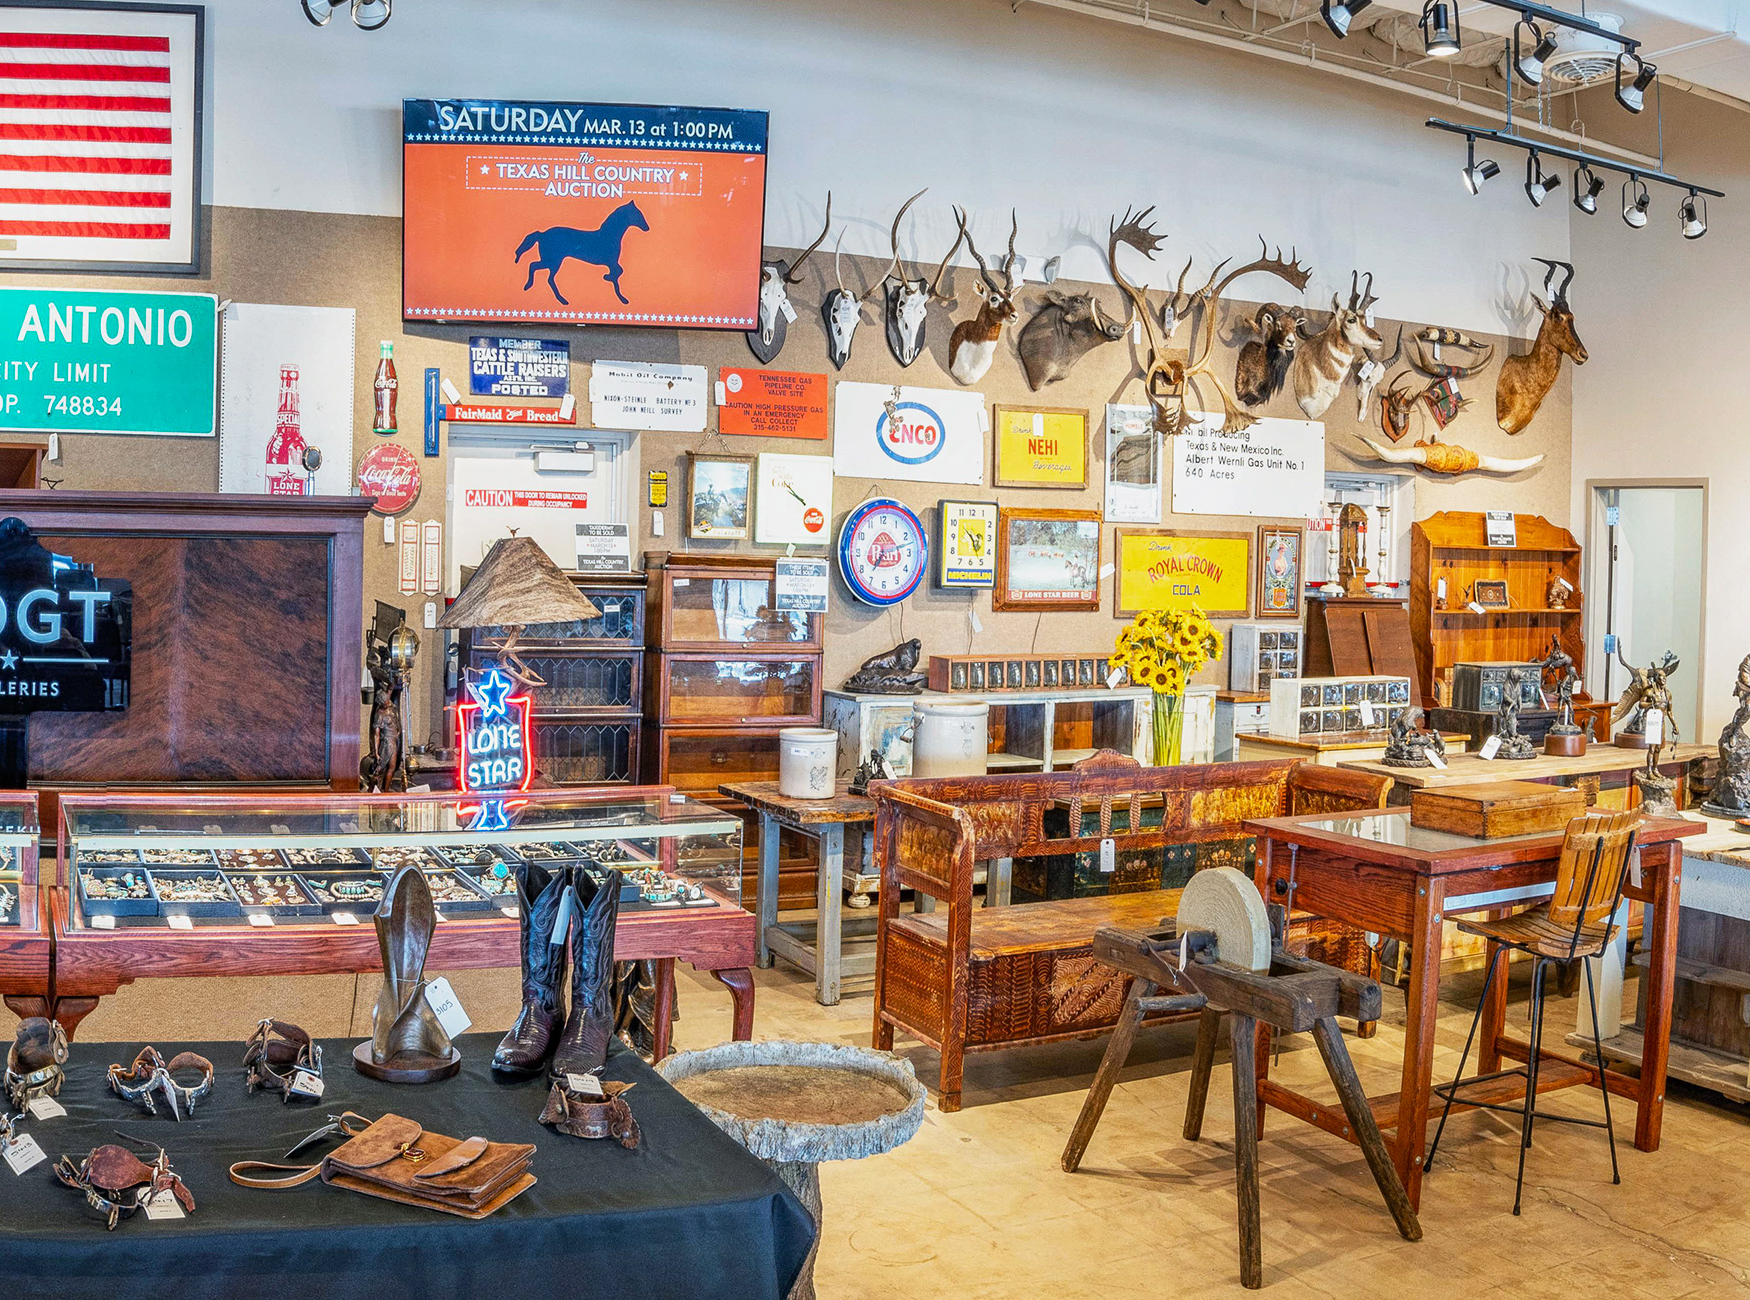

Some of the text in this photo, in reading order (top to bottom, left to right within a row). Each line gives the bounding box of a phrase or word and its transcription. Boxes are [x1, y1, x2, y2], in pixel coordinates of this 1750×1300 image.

[440, 106, 733, 139] SATURDAY MAR. 13 at 1:00 PM
[577, 152, 595, 165] The
[496, 163, 675, 183] TEXAS HILL COUNTRY
[545, 182, 623, 199] AUCTION
[17, 303, 193, 348] ANTONIO
[499, 338, 542, 350] MEMBER
[471, 347, 568, 365] TEXAS & SOUTHWESTERN
[53, 363, 112, 384] LIMIT
[473, 361, 567, 378] CATTLE RAISERS
[653, 373, 693, 381] Company
[759, 375, 796, 383] TENNESSEE
[491, 384, 548, 396] POSTED
[43, 395, 123, 416] 748834
[774, 404, 808, 412] PRESSURE
[455, 407, 502, 420] FairMaid
[526, 410, 559, 421] Bread
[765, 411, 805, 419] EMERGENCY
[769, 418, 798, 426] COLLECT
[1028, 439, 1058, 456] NEHI
[1186, 440, 1284, 456] Texas & New Mexico Inc.
[1186, 454, 1214, 465] Albert
[1218, 456, 1245, 466] Wernli
[1248, 458, 1264, 468] Gas
[1266, 459, 1283, 469] Unit
[1285, 460, 1298, 470] No.
[1032, 461, 1073, 476] Beverages
[1185, 468, 1235, 479] 640 Acres
[274, 482, 300, 490] LONE
[466, 490, 513, 506] CAUTION
[868, 520, 873, 529] 11
[880, 516, 887, 524] 12
[858, 532, 865, 540] 10
[903, 532, 908, 540] 2
[986, 548, 991, 556] 4
[1148, 541, 1172, 552] Drink
[856, 549, 861, 557] 9
[871, 544, 898, 561] Pearl
[907, 549, 911, 557] 3
[979, 558, 983, 566] 5
[860, 565, 864, 573] 8
[903, 565, 908, 573] 4
[1148, 556, 1223, 584] ROYAL CROWN
[895, 576, 899, 584] 5
[948, 571, 992, 580] MICHELIN
[882, 581, 886, 589] 6
[1172, 585, 1201, 596] COLA
[1062, 591, 1079, 599] BEER
[467, 724, 521, 754] LONE
[468, 757, 522, 788] STAR
[435, 999, 454, 1016] 3105
